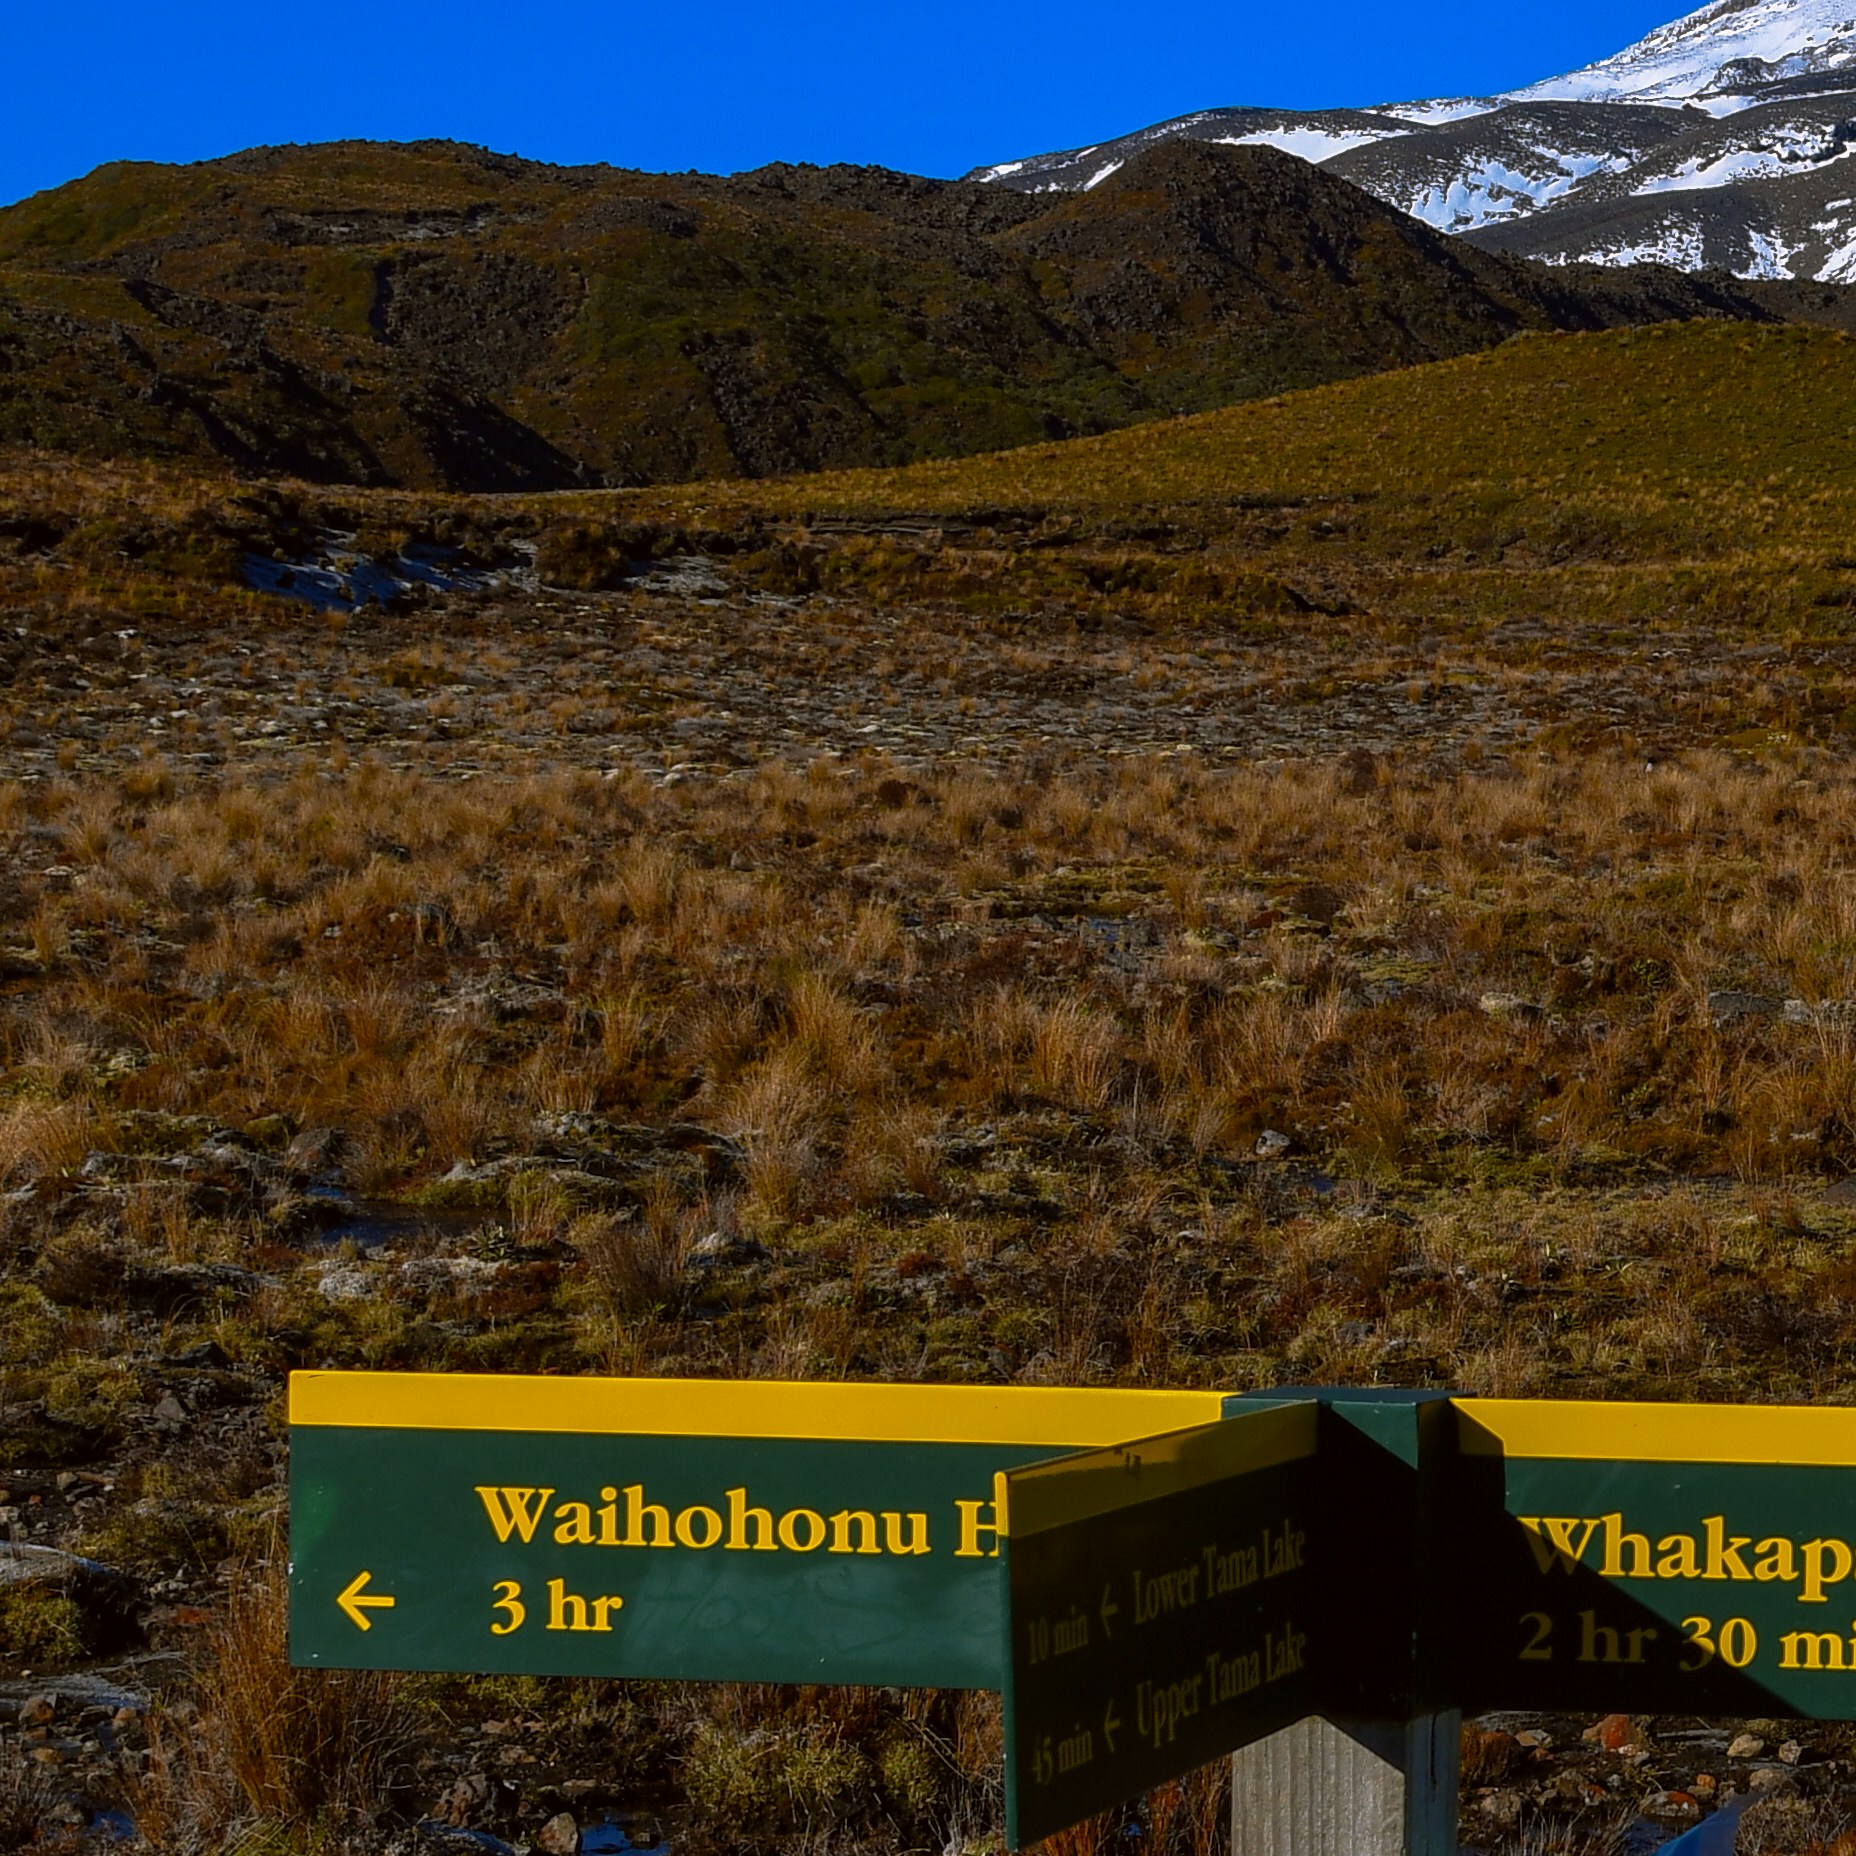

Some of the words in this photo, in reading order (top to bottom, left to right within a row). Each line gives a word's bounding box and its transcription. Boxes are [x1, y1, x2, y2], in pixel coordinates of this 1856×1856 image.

[475, 1484, 933, 1557] Waihohonu
[491, 1580, 528, 1637] 3
[546, 1578, 625, 1634] hr
[1028, 1616, 1050, 1666] 10
[1053, 1604, 1089, 1656] min
[1132, 1563, 1200, 1626] Lower
[1202, 1542, 1259, 1599] Tama
[1262, 1517, 1306, 1579] Lake
[1517, 1610, 1554, 1661] 2
[1575, 1609, 1659, 1664] hr
[1678, 1615, 1760, 1672] 30
[1031, 1733, 1055, 1786] 45
[1057, 1721, 1094, 1774] min
[1135, 1672, 1203, 1750] Upper
[1205, 1651, 1261, 1706] Tama
[1264, 1620, 1307, 1683] Lake
